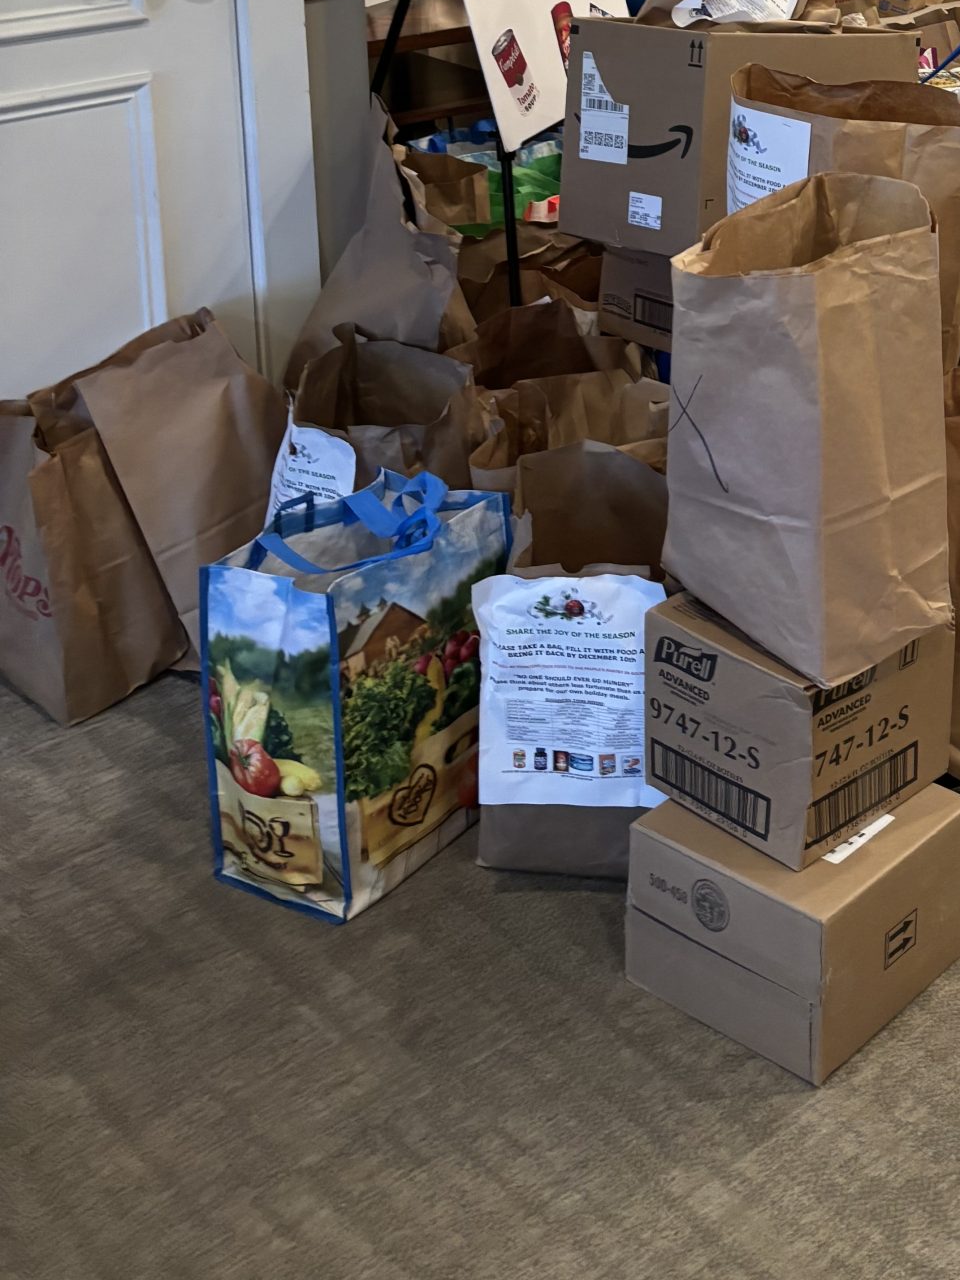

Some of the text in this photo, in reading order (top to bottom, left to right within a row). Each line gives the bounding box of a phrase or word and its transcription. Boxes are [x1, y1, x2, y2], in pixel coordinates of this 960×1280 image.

[759, 162, 781, 172] SEASON
[311, 472, 336, 480] SEASON
[602, 631, 636, 639] SEASON
[508, 650, 533, 658] BRING
[662, 639, 711, 680] Purell
[659, 669, 710, 701] ADVANCED
[817, 693, 872, 728] ADVANCED
[650, 697, 760, 770] 9747-12-S
[815, 704, 909, 777] 747-12-S
